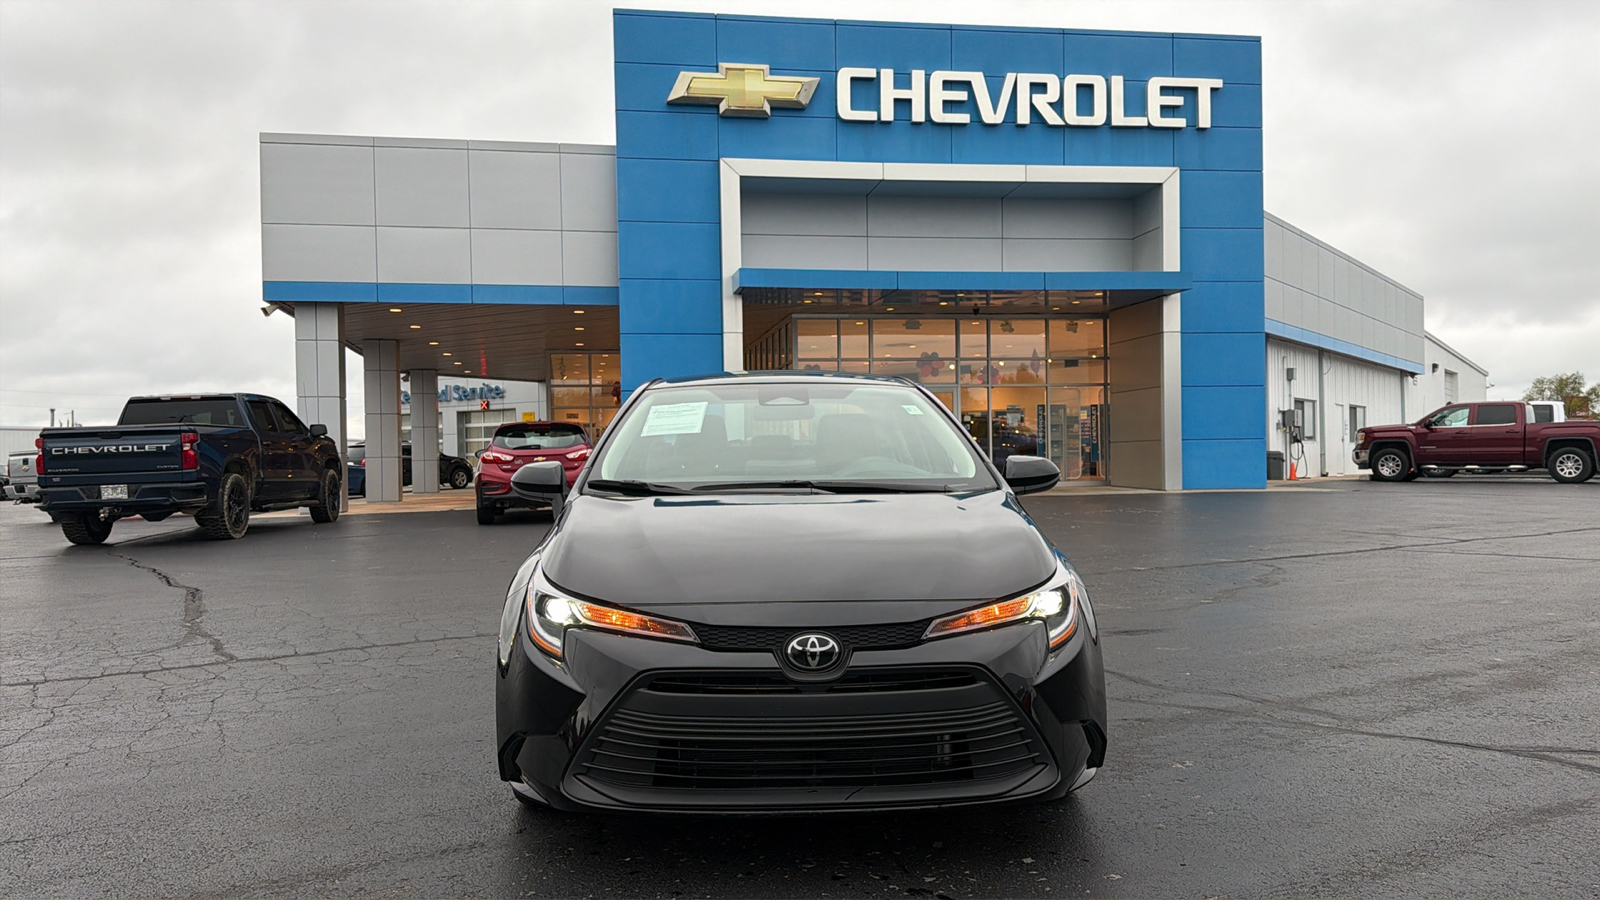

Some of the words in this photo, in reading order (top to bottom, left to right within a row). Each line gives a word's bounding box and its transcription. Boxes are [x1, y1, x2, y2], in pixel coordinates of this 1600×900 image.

[836, 67, 1223, 130] CHEVROLET
[452, 382, 503, 401] Service
[51, 443, 171, 455] CHEVROLET
